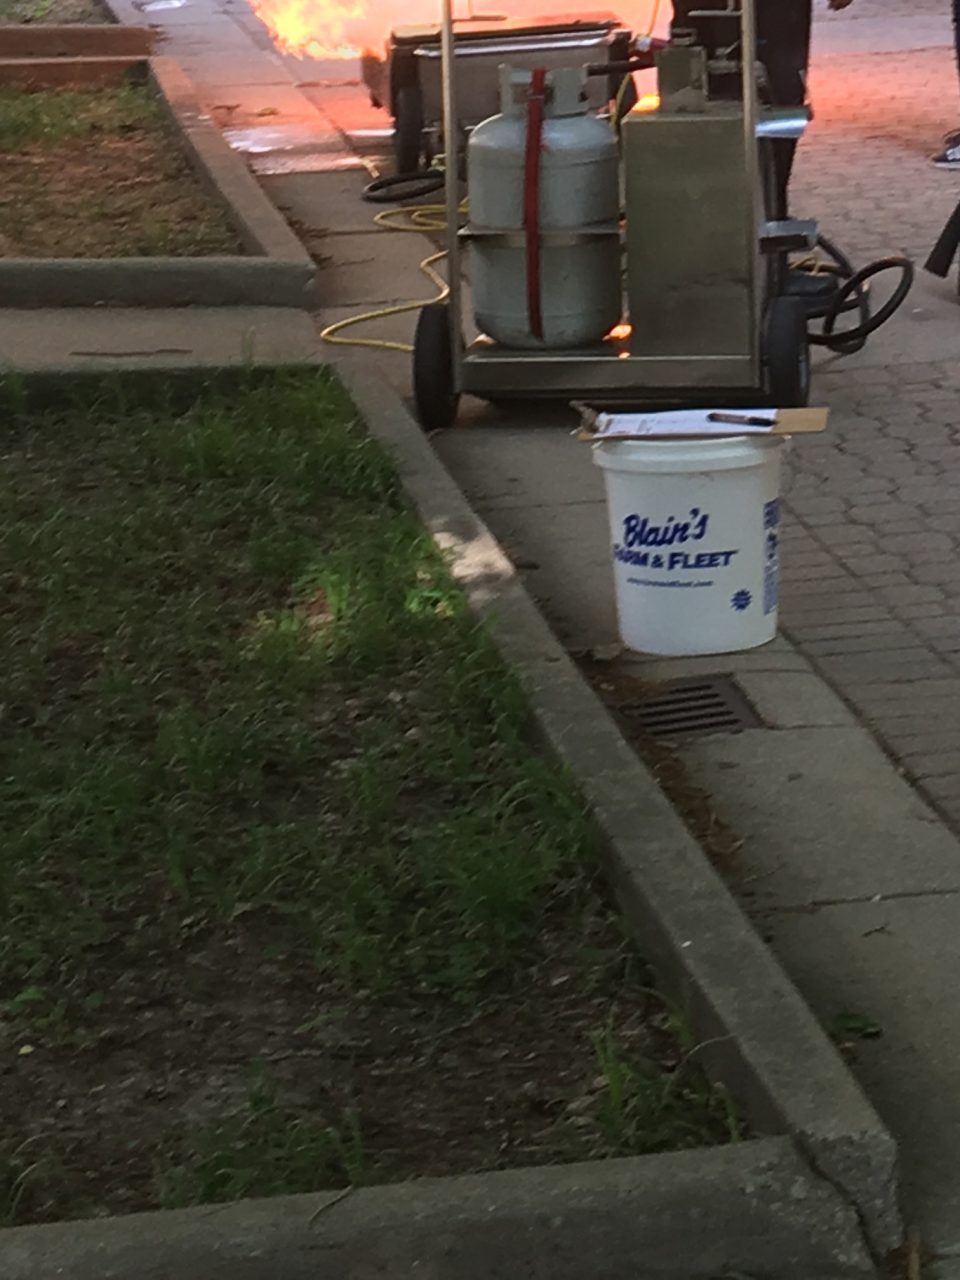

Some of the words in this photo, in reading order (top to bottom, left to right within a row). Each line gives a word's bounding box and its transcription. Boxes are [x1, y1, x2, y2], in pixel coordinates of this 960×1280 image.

[623, 507, 709, 548] Blain's
[651, 554, 663, 568] &
[667, 550, 739, 571] FLEET
